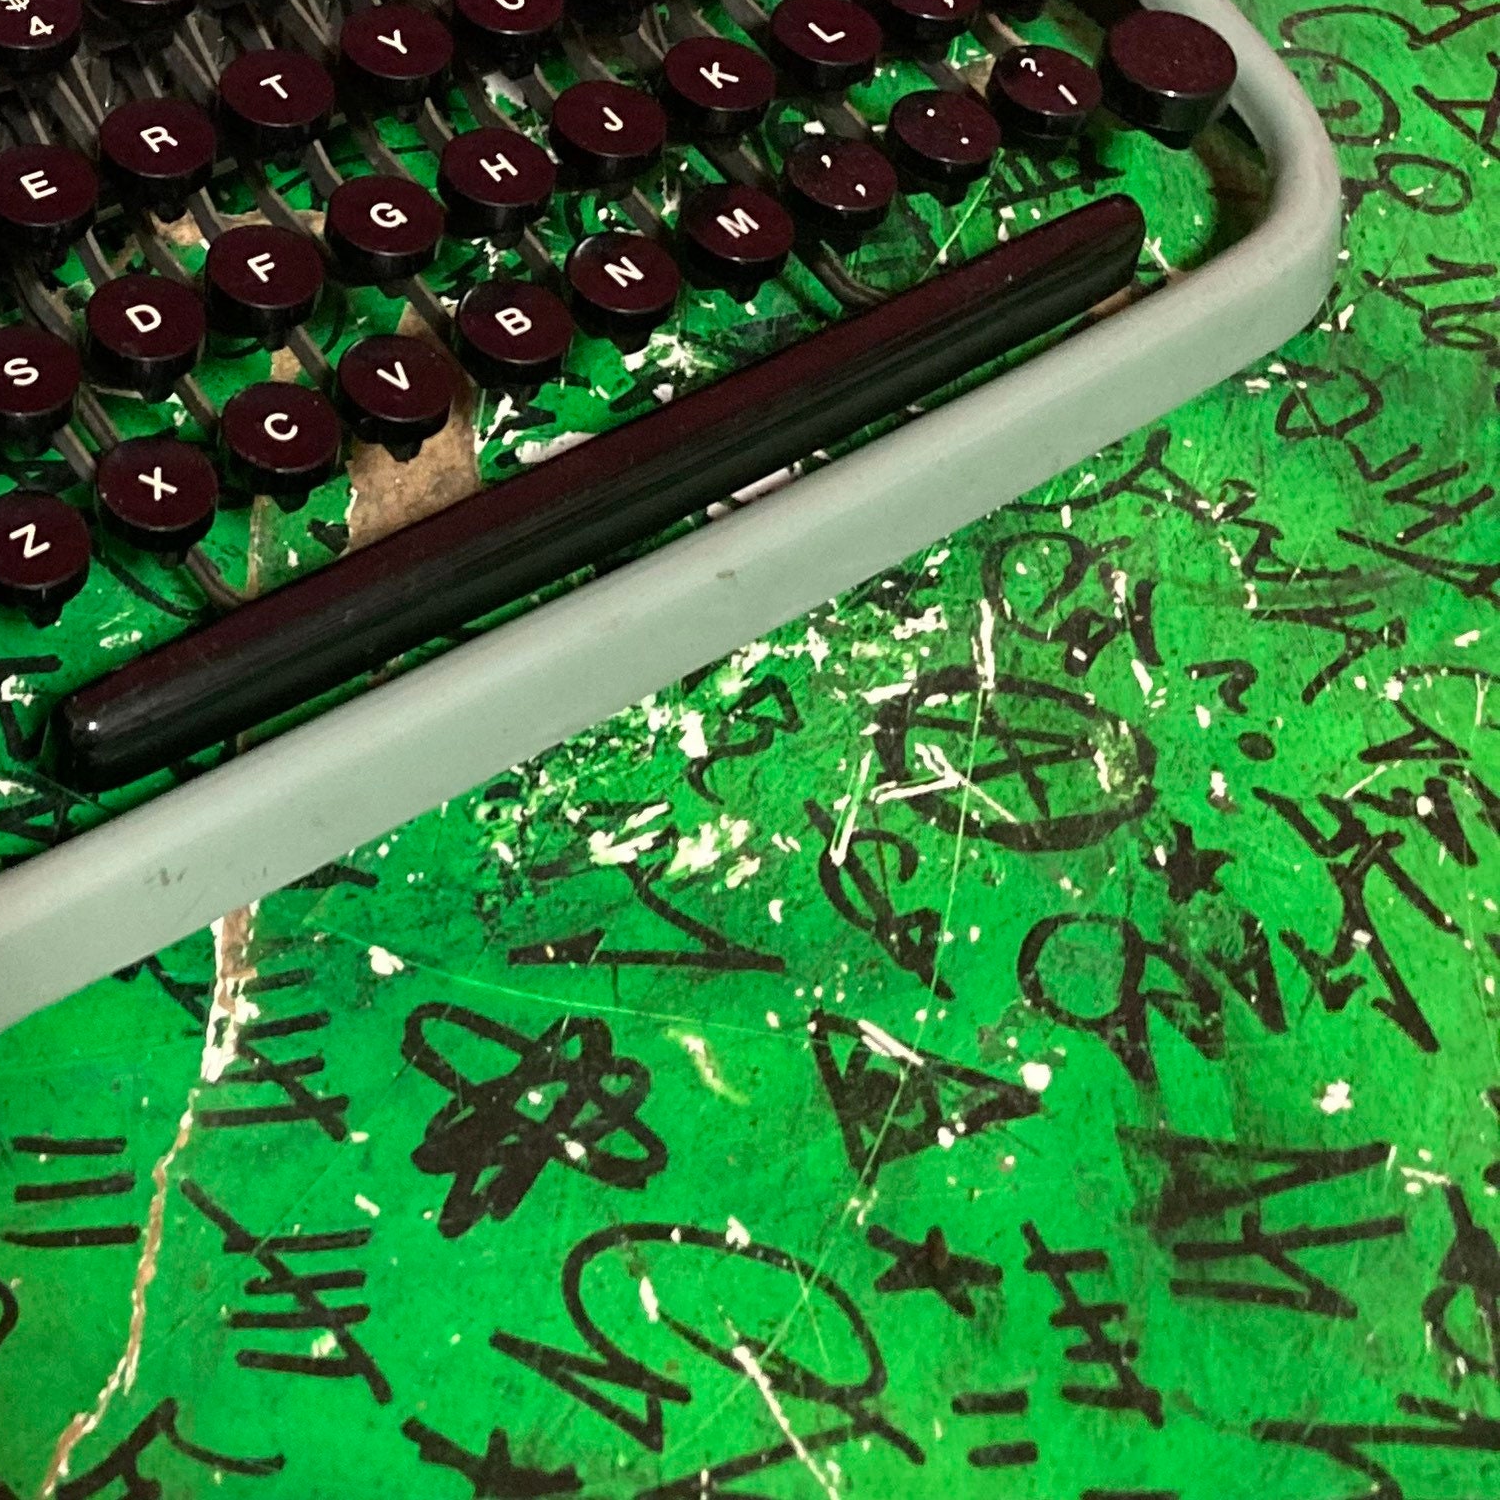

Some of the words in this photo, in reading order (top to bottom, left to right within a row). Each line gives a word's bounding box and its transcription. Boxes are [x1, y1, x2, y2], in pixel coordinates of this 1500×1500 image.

[29, 15, 55, 37] 4
[808, 22, 846, 43] L
[377, 29, 408, 55] Y
[259, 74, 289, 99] T
[699, 61, 739, 89] K
[603, 106, 624, 132] J
[139, 126, 179, 153] R
[479, 152, 519, 182] H
[19, 170, 58, 200] E
[369, 202, 408, 228] G
[716, 208, 760, 238] M
[246, 252, 275, 283] F
[603, 256, 644, 288] N
[125, 304, 162, 333] D
[494, 307, 532, 336] B
[3, 357, 39, 386] S
[376, 361, 410, 391] V
[263, 412, 299, 441] C
[138, 466, 178, 501] X
[9, 523, 50, 559] Z
